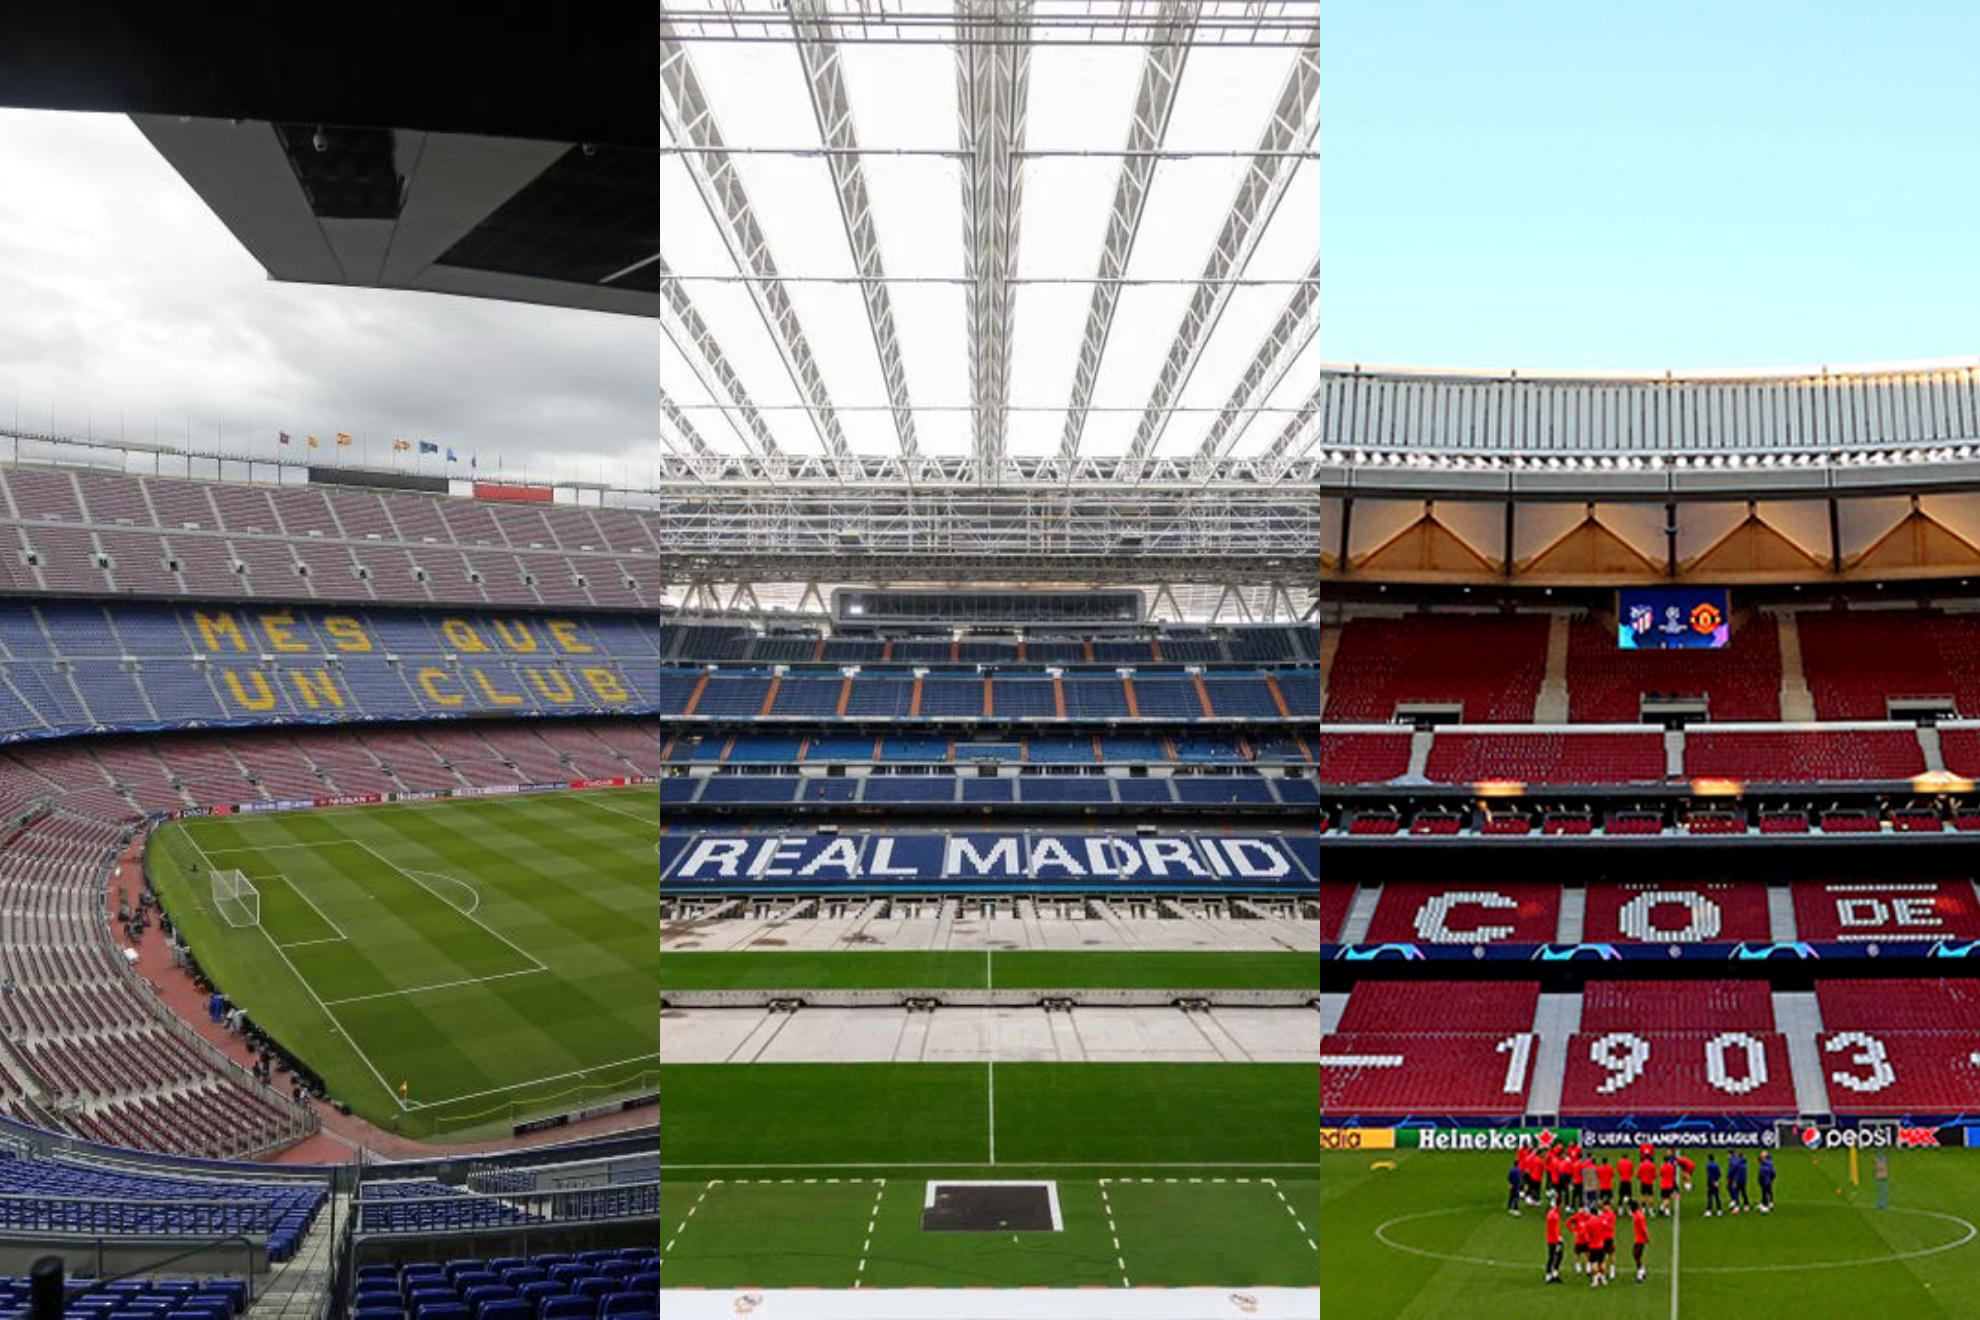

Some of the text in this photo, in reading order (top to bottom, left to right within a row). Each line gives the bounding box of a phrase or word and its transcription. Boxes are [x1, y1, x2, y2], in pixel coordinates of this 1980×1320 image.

[443, 619, 592, 652] QUE
[224, 667, 628, 711] UN CLUB
[678, 836, 1291, 878] REAL MADRID
[1836, 898, 1943, 927] DE
[1418, 1128, 1533, 1149] Heineken
[1598, 1130, 1759, 1146] UEFA CHAMPIONS LEAGUE
[1826, 1127, 1940, 1149] pepsi MAX
